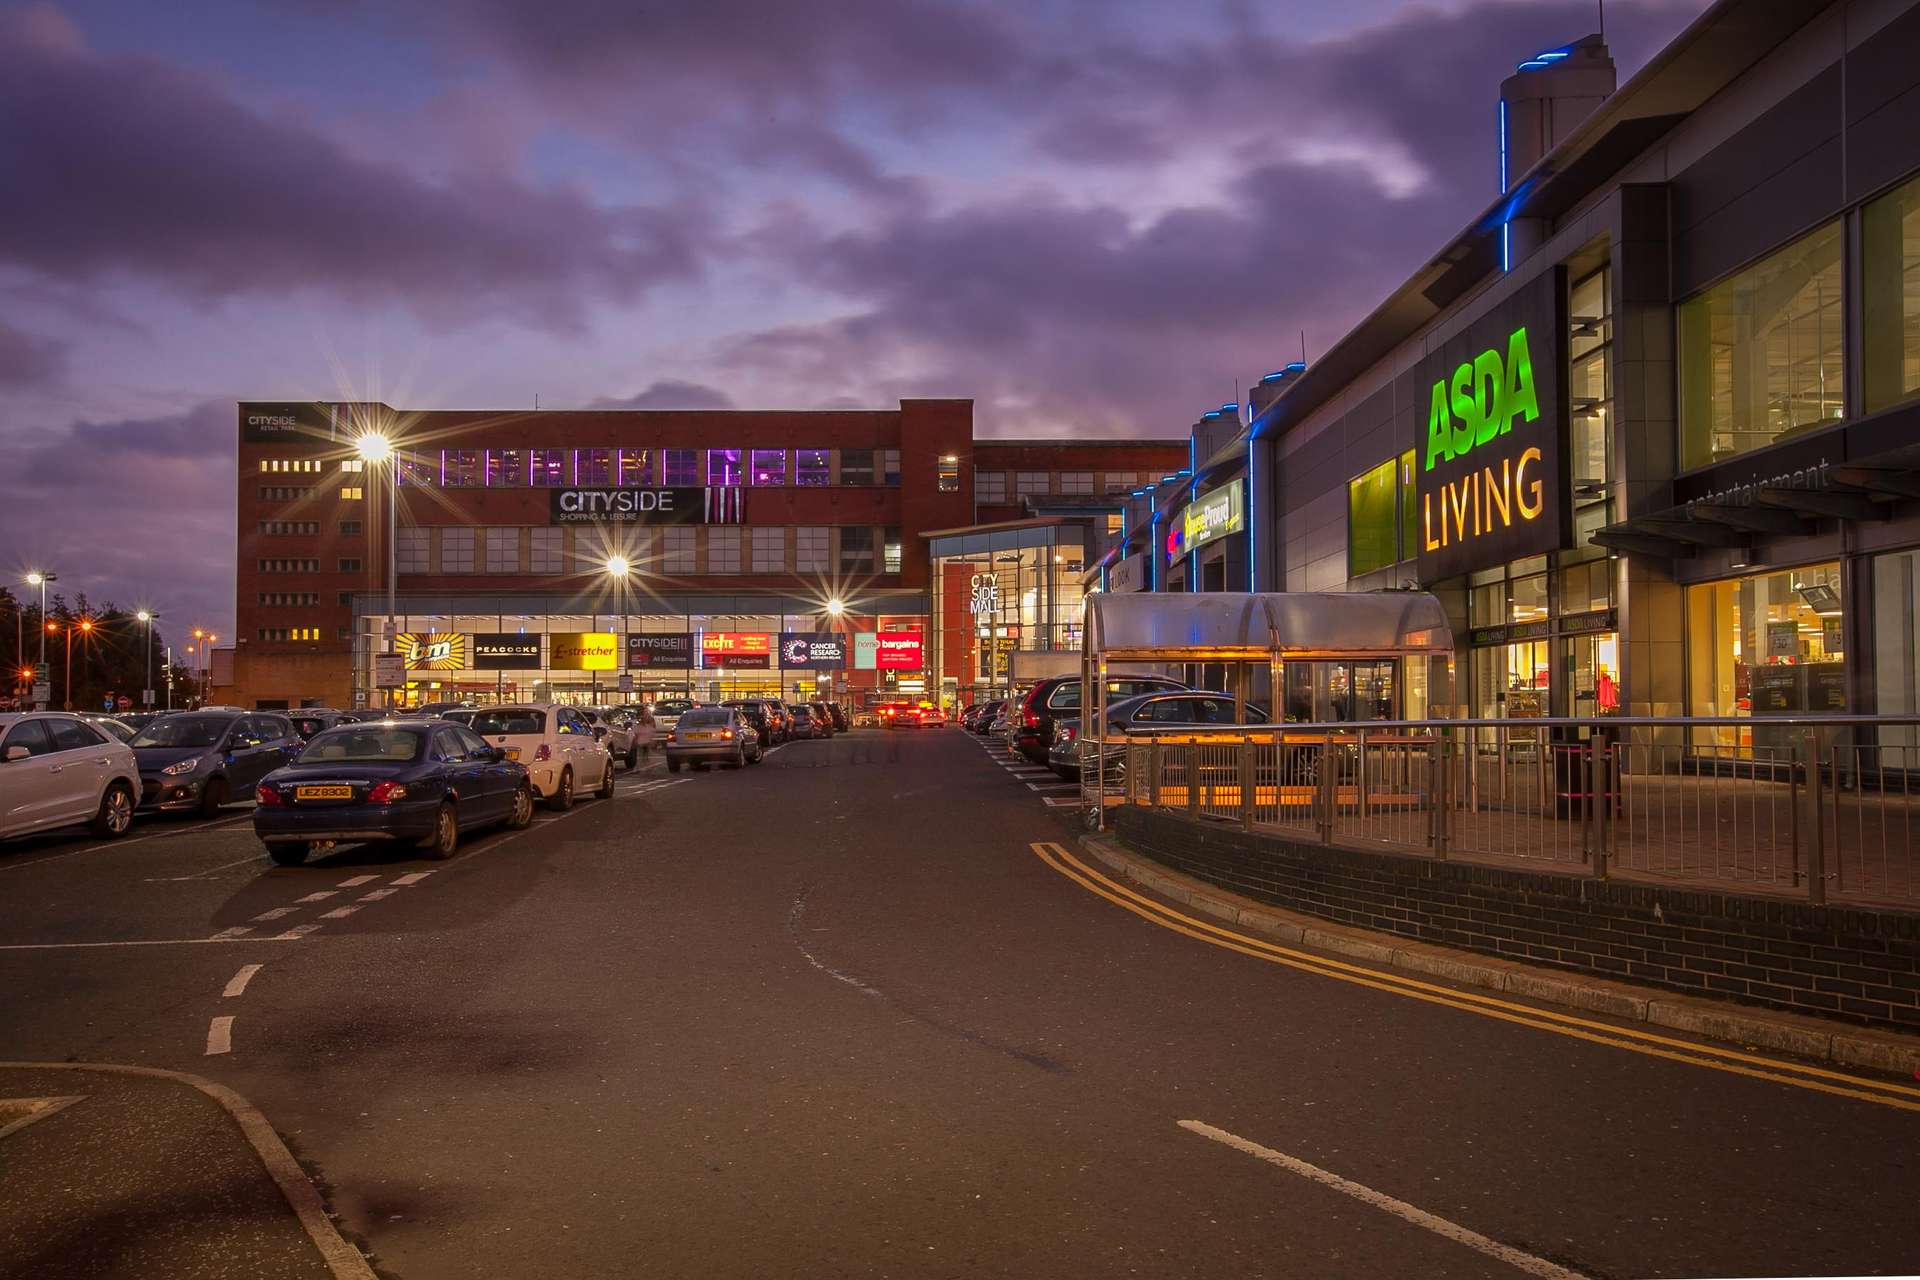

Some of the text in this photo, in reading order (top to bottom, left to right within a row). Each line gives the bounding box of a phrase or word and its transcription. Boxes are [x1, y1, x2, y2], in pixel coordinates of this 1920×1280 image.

[1425, 327, 1540, 471] ASDA
[248, 415, 296, 425] CITYSIDE
[559, 491, 674, 512] CITYSIDE
[1424, 447, 1543, 552] LIVING
[560, 513, 599, 521] SHOPPING
[971, 574, 998, 588] CTY
[971, 587, 999, 601] SIDE
[970, 600, 1001, 614] MALL
[629, 638, 679, 648] CITYSIDE
[703, 633, 734, 651] EXCITE
[882, 640, 919, 650] bargains
